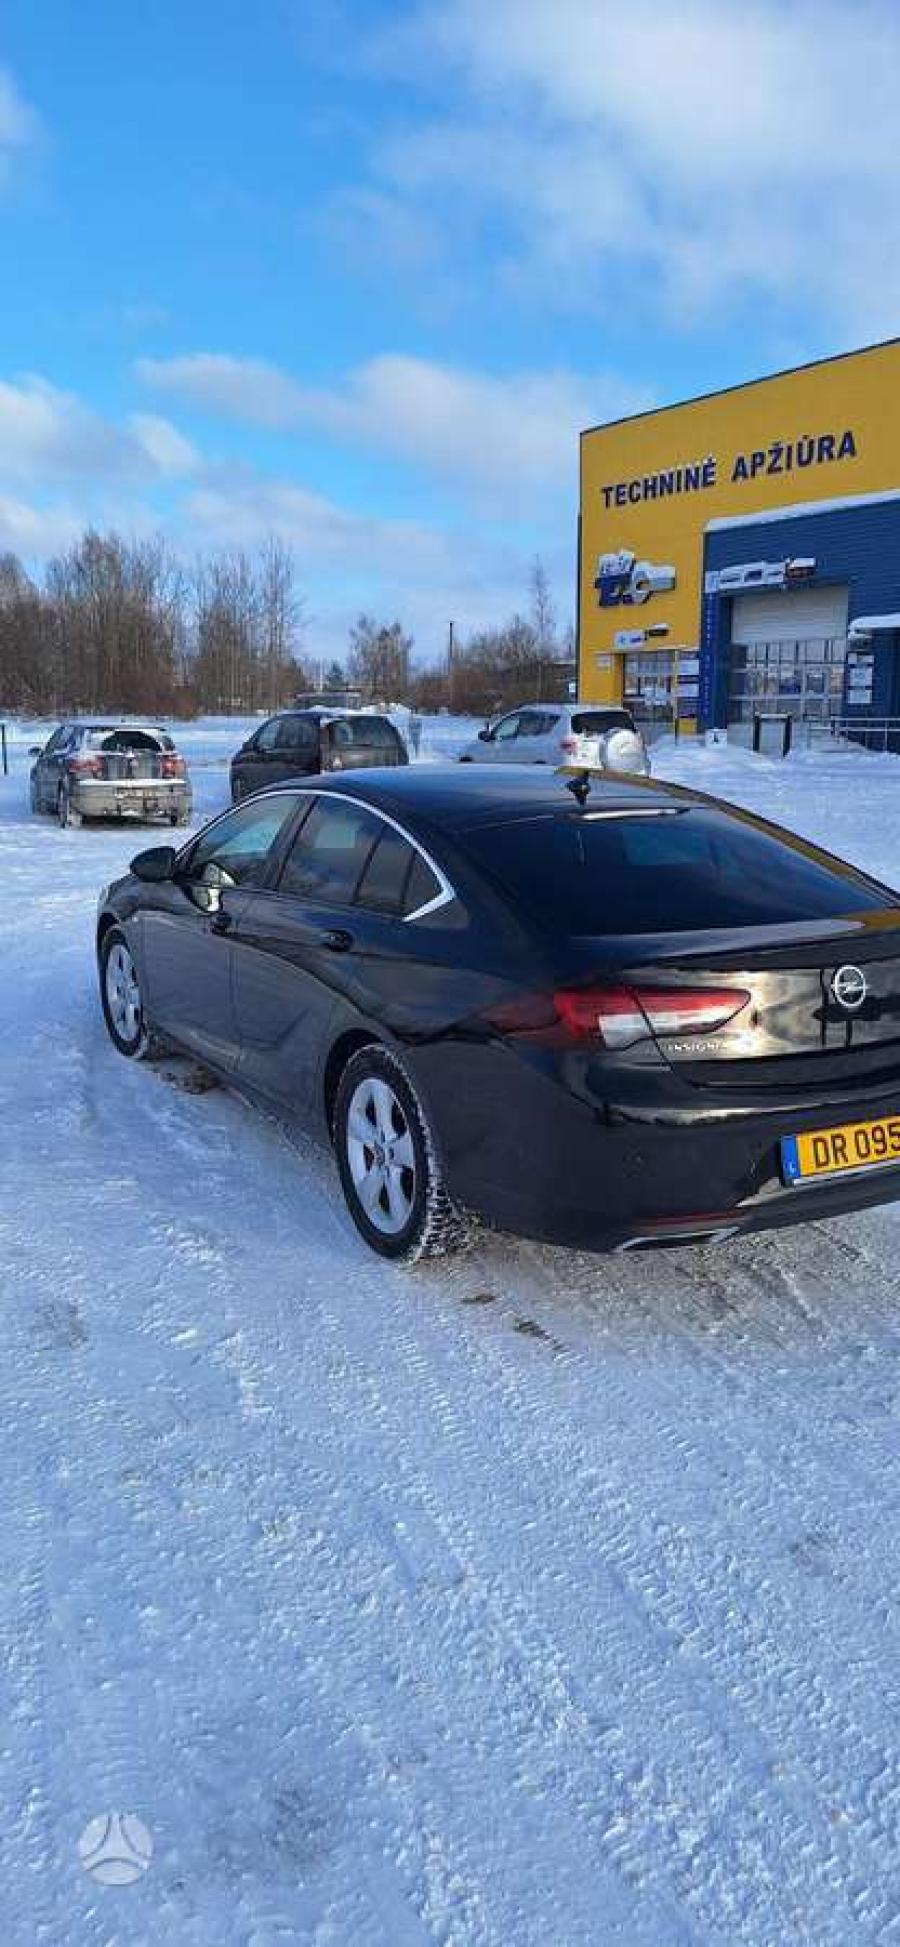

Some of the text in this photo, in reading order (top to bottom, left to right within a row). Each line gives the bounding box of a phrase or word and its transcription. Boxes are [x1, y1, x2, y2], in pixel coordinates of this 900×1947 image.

[601, 430, 857, 508] TECHNINĖ APŽIŪRA
[812, 1121, 900, 1168] DR 095
